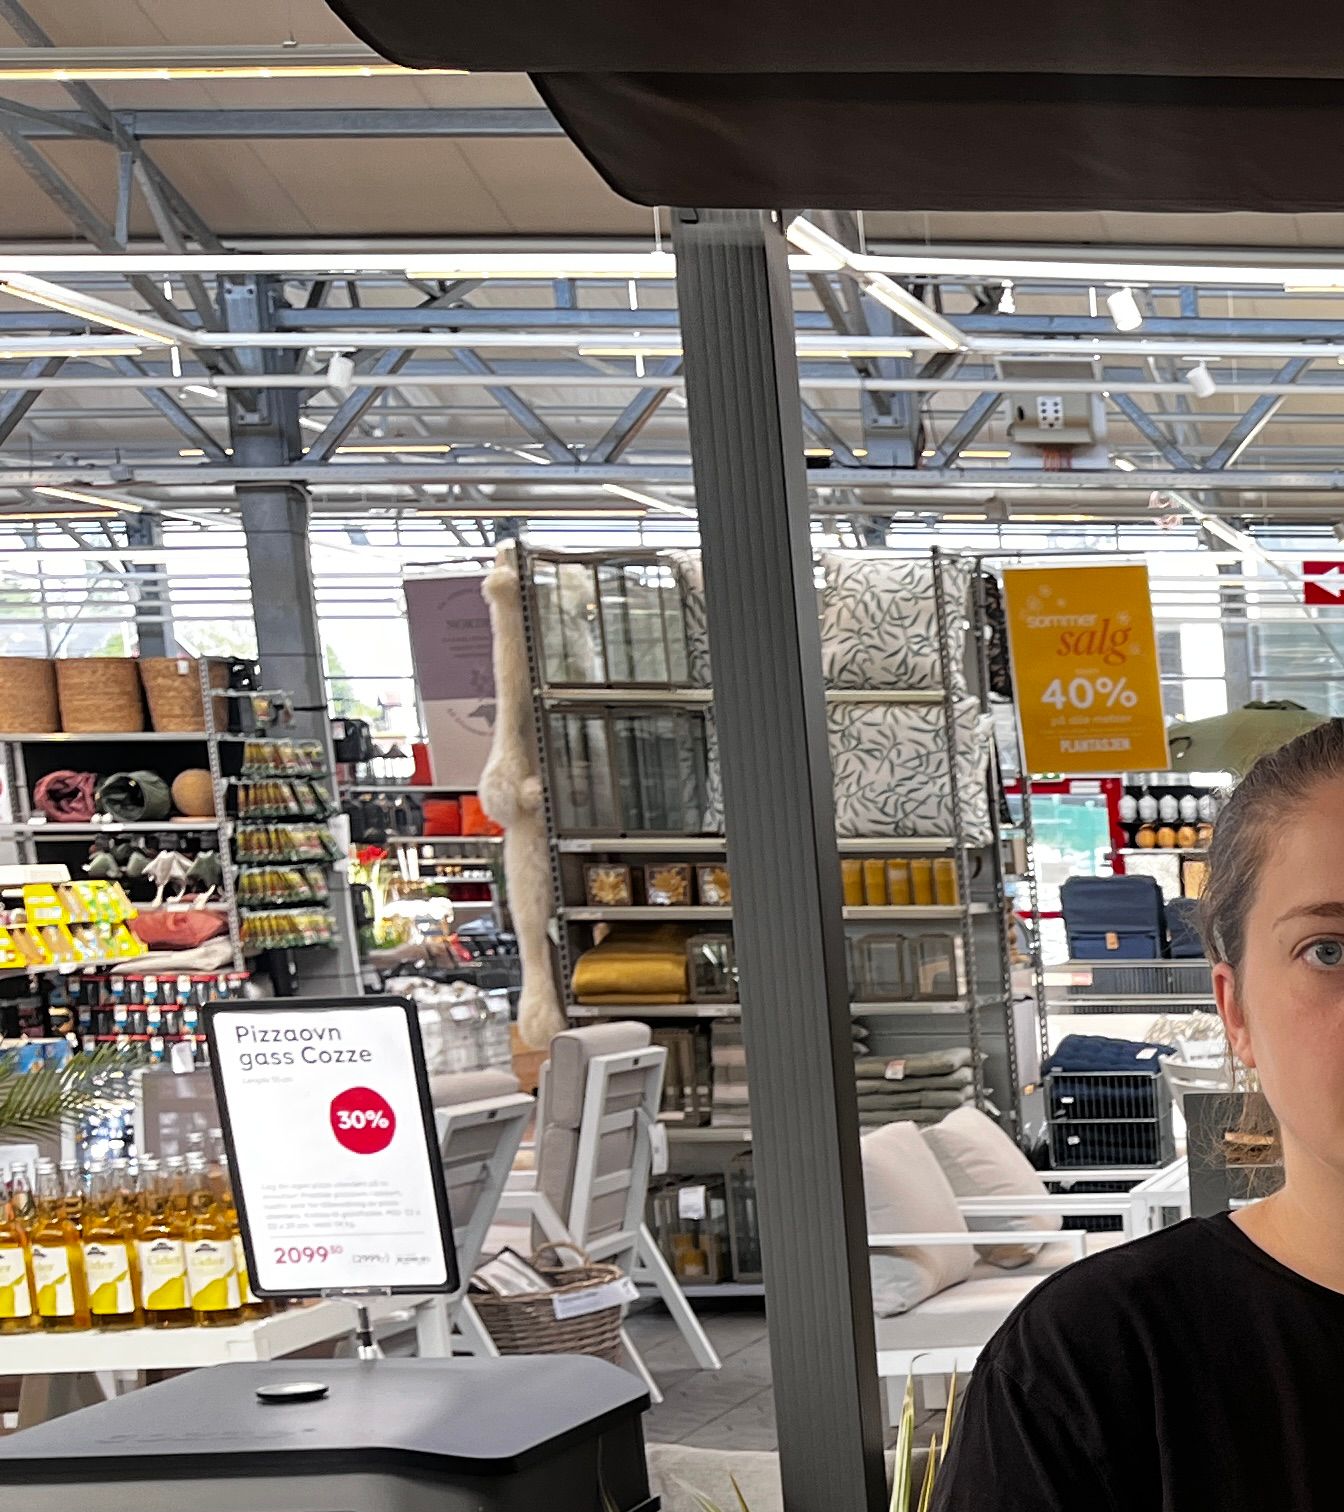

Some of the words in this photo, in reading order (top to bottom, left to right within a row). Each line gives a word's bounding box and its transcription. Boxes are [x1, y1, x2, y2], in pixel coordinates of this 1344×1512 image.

[1056, 618, 1132, 667] salg
[1041, 676, 1138, 710] 40%
[235, 1025, 342, 1044] Pizzaovn
[239, 1051, 295, 1071] gass
[301, 1046, 373, 1064] Cozze
[336, 1109, 390, 1130] 30%
